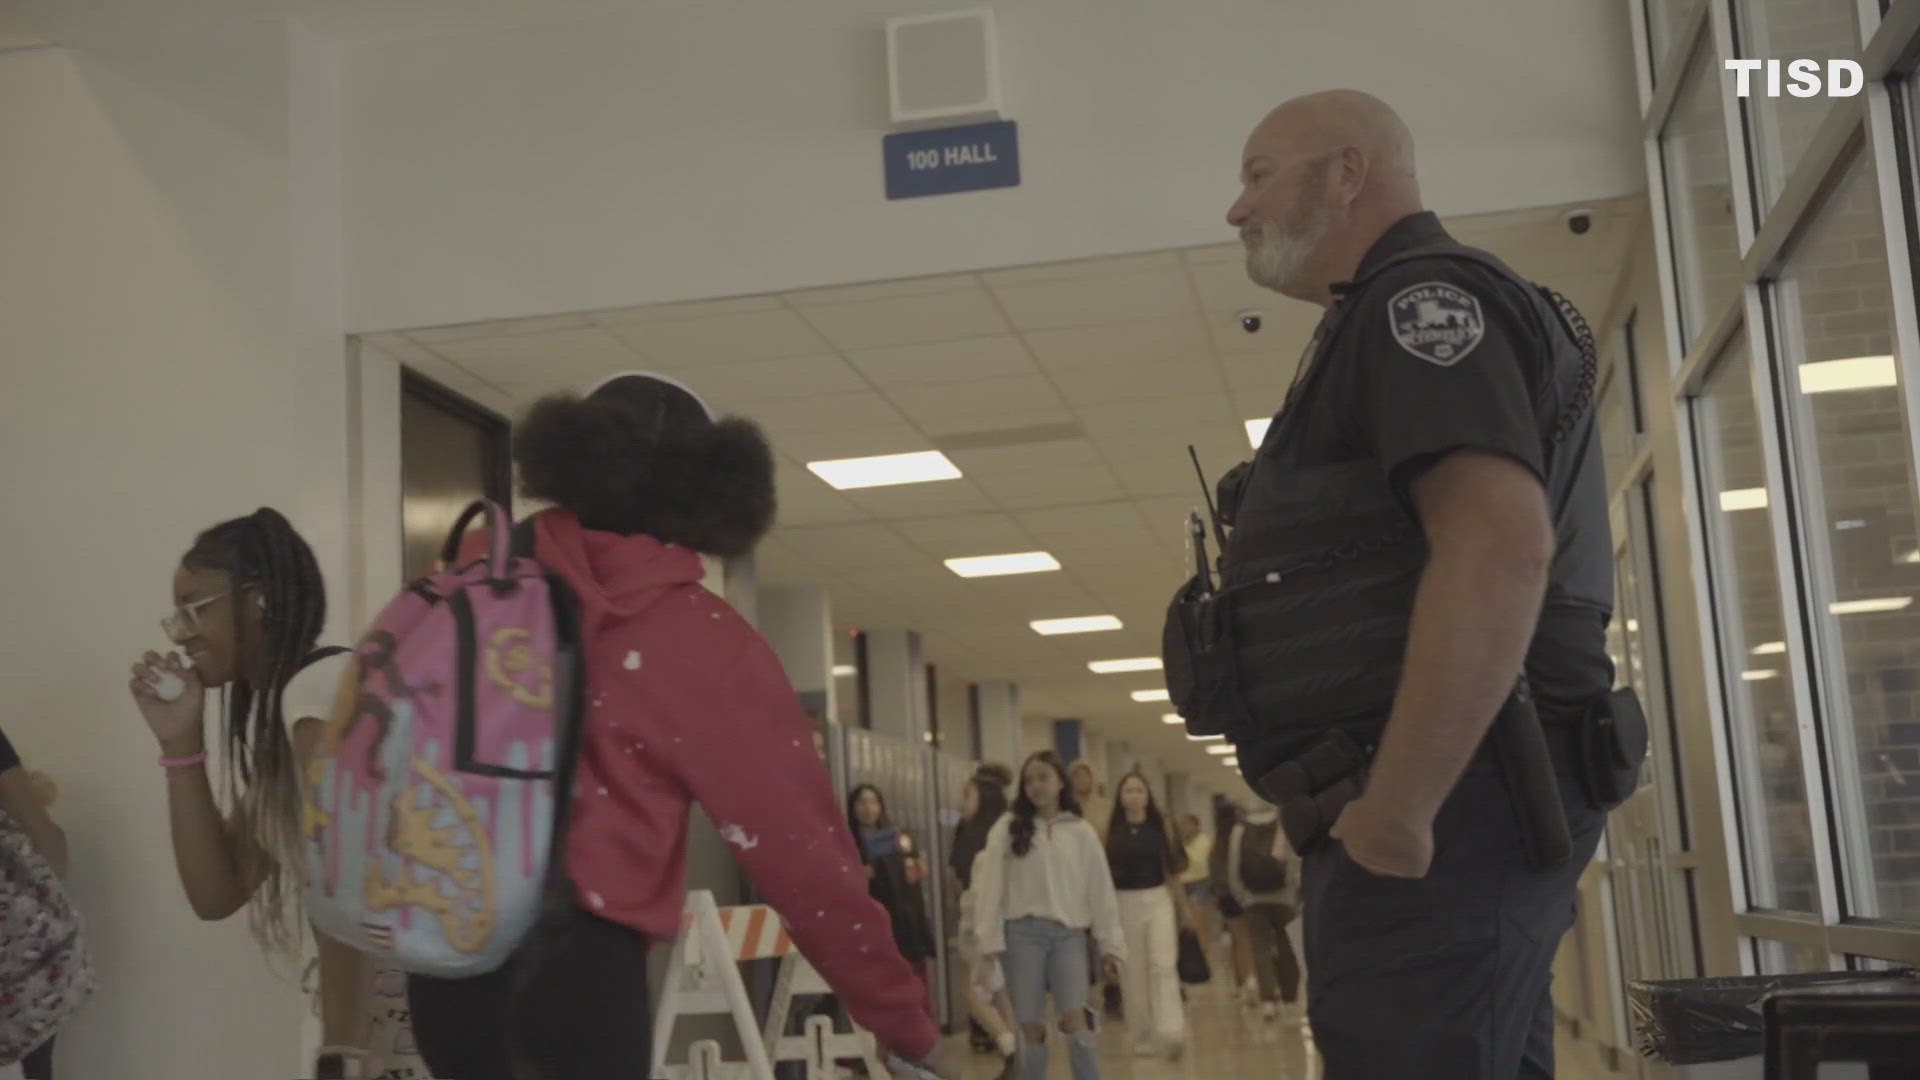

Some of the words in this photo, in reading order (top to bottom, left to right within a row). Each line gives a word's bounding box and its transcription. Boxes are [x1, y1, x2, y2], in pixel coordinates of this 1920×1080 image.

[906, 149, 939, 170] 100
[943, 143, 998, 166] HALL
[1396, 287, 1472, 309] POLICE
